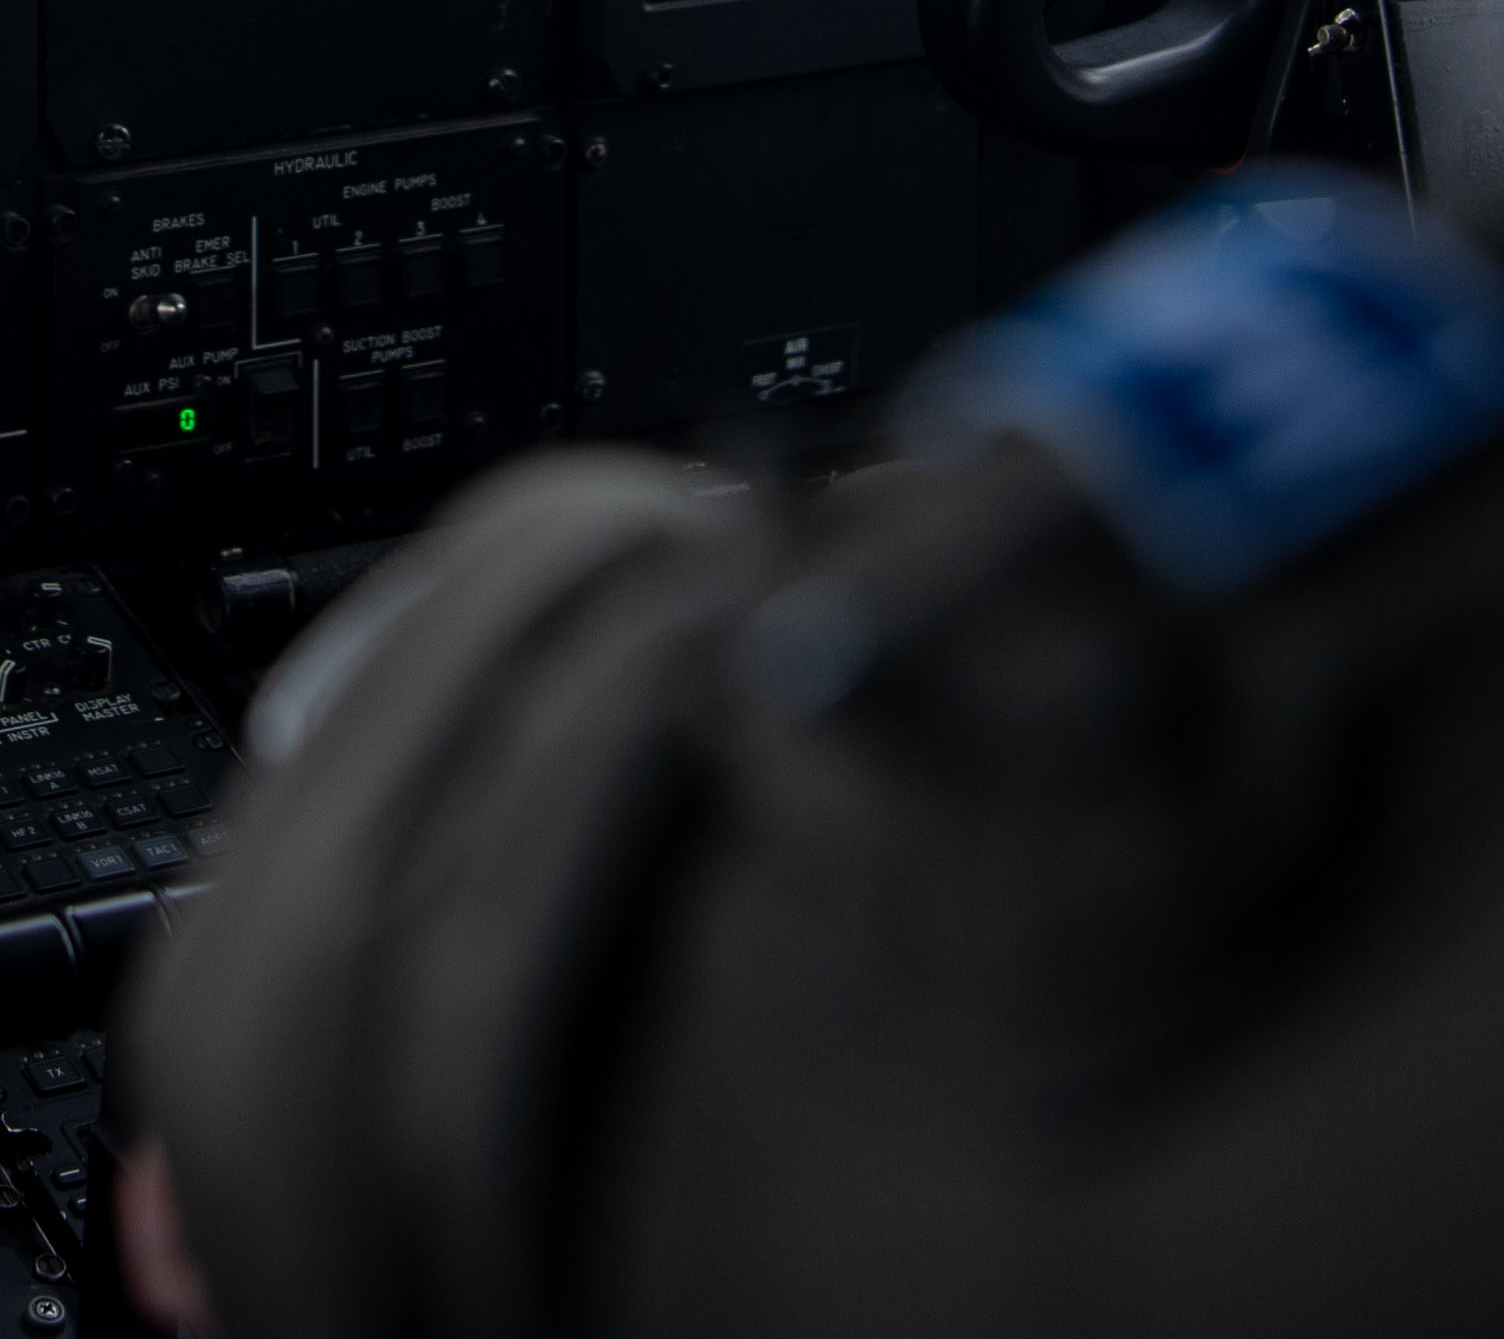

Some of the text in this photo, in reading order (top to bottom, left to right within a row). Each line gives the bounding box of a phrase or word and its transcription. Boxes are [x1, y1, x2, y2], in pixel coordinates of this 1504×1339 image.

[274, 150, 357, 175] HYDRAULIC
[343, 174, 436, 199] ENGINE PUMPS
[432, 193, 472, 211] BOOST
[153, 213, 205, 232] BRAKES
[313, 214, 341, 229] UTIL
[131, 246, 161, 262] ANTI
[131, 264, 160, 280] SKID
[169, 348, 239, 370] AUX PUMP
